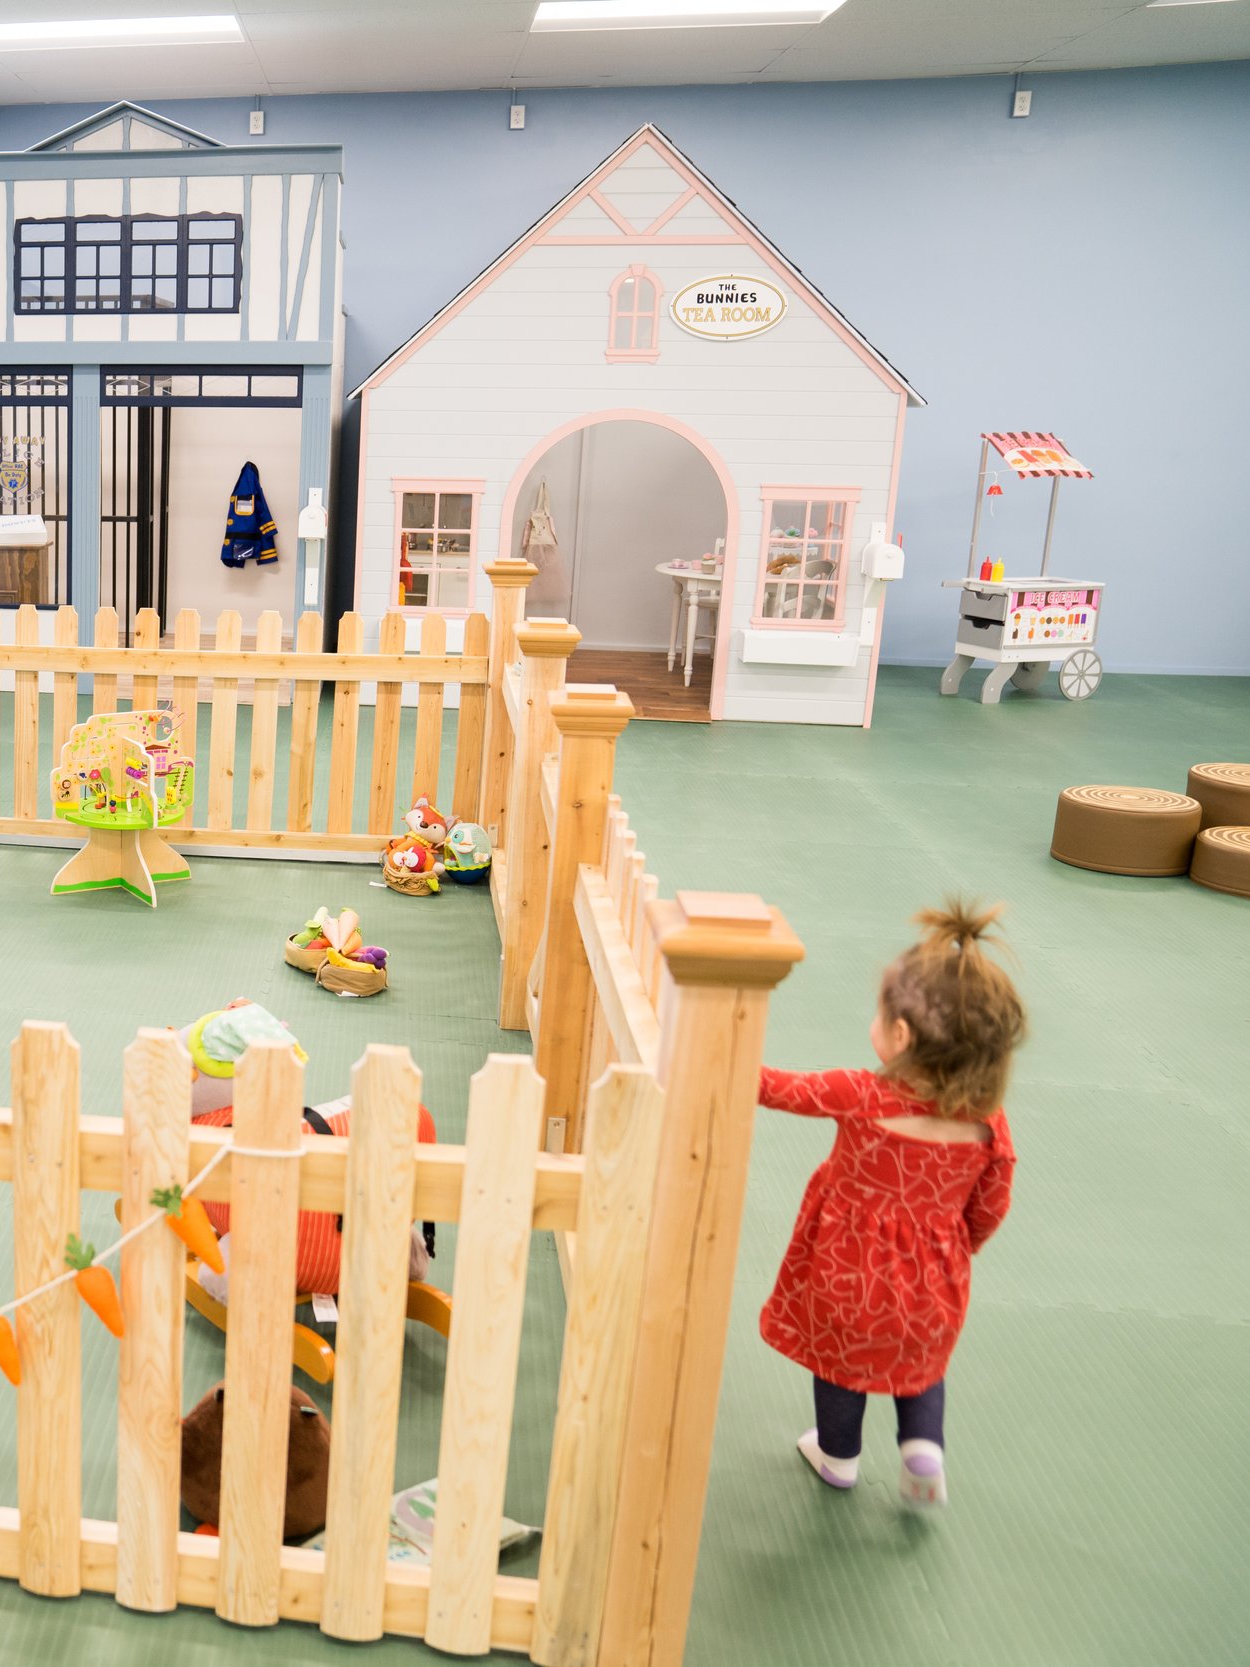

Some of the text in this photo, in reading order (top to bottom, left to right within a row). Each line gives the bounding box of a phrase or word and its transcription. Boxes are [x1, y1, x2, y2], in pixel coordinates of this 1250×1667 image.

[696, 292, 757, 304] BUNNIES
[682, 307, 772, 322] TEA ROOM
[12, 435, 46, 447] AWAY
[1030, 590, 1081, 605] ICE CREAM
